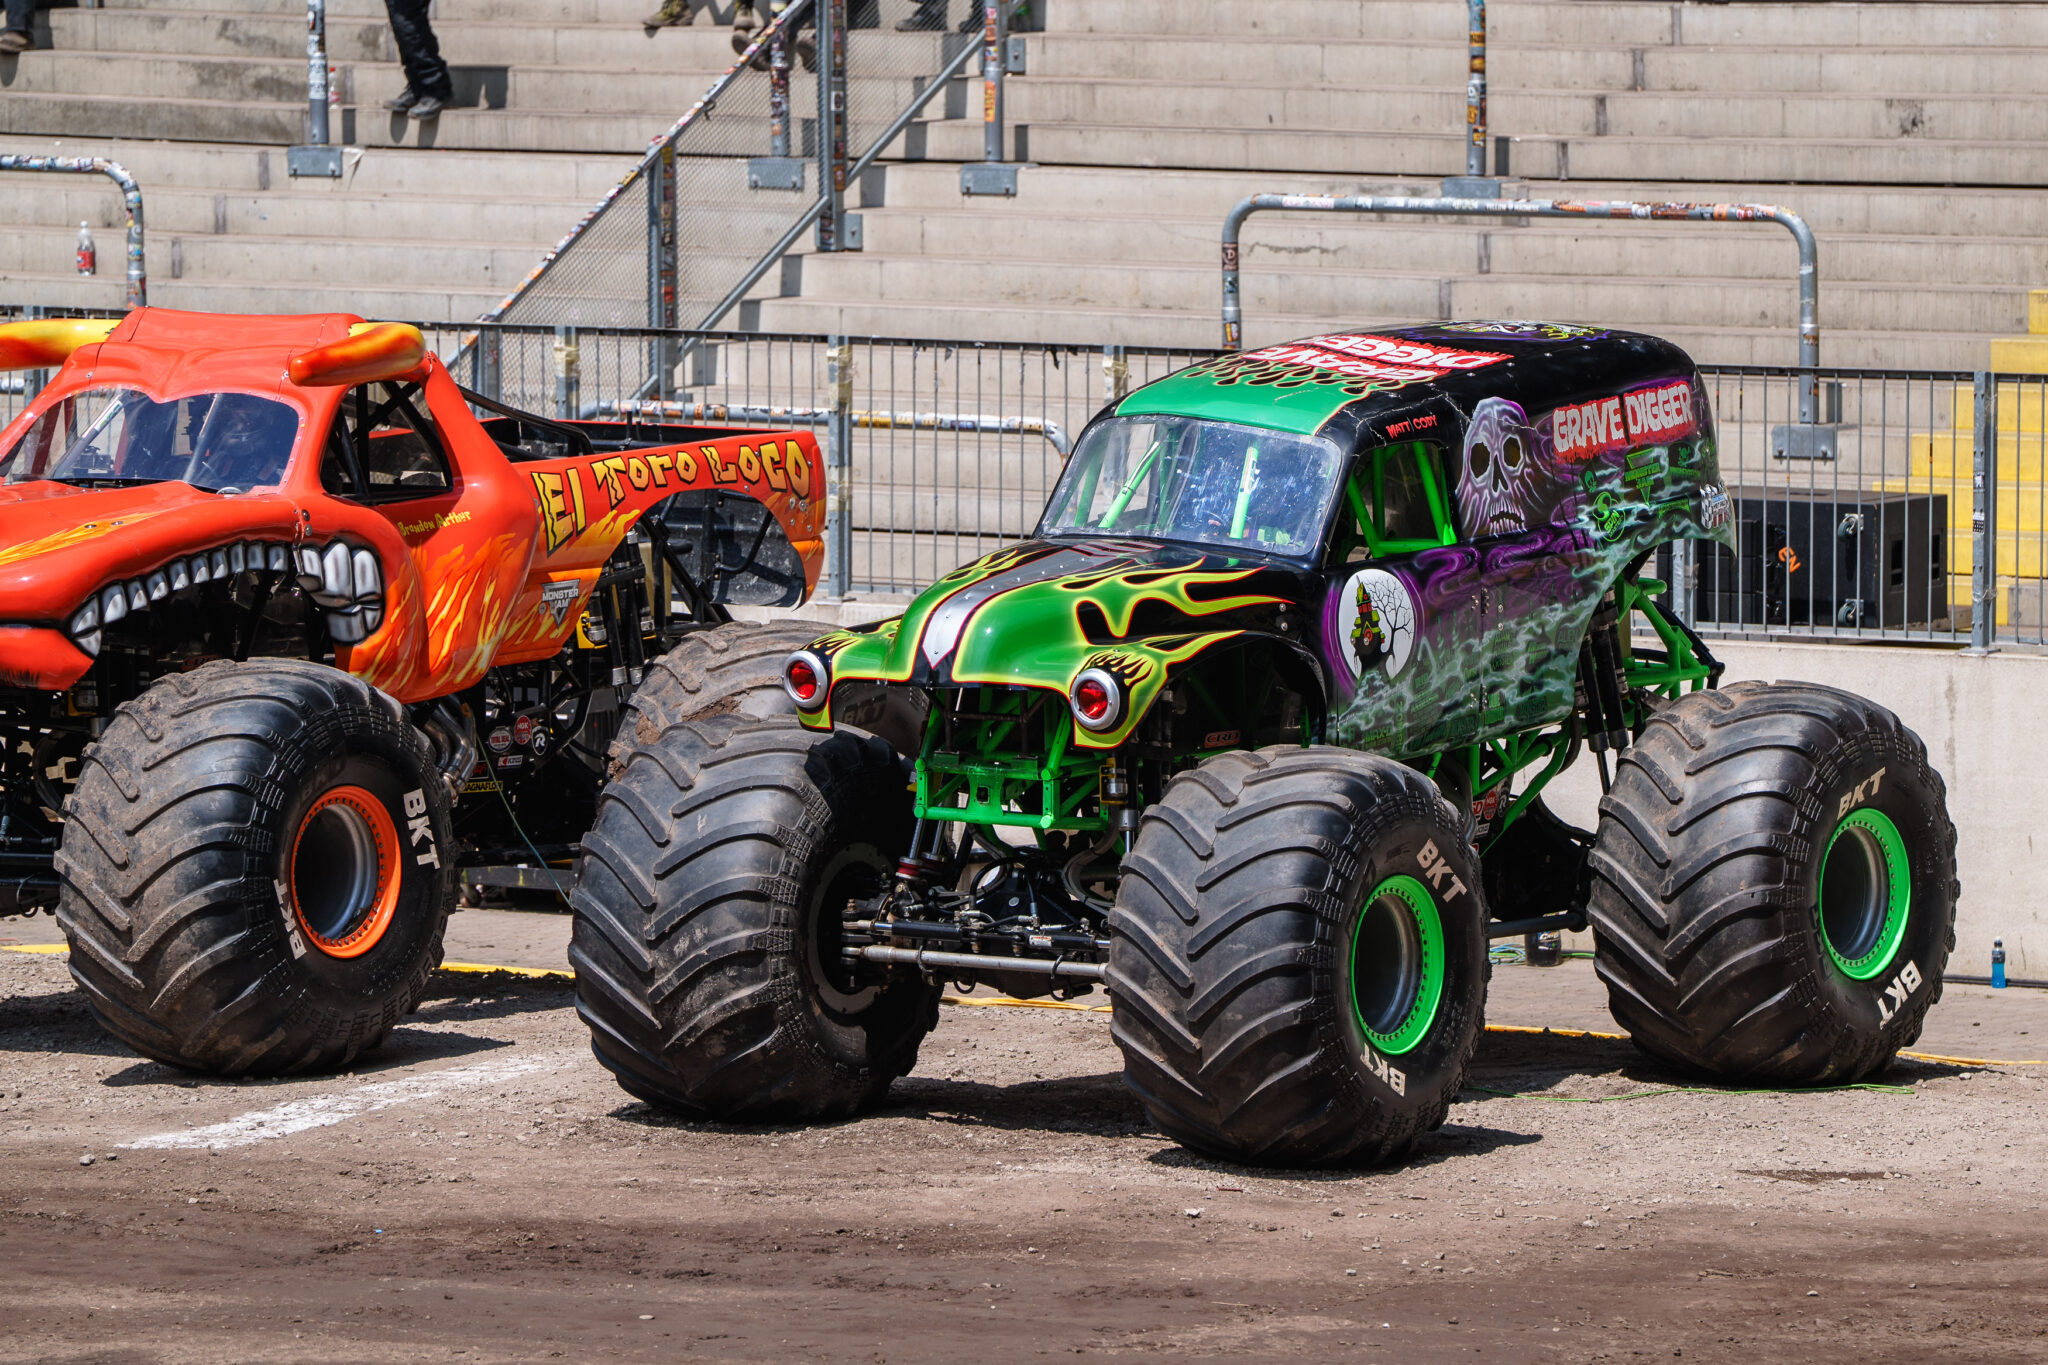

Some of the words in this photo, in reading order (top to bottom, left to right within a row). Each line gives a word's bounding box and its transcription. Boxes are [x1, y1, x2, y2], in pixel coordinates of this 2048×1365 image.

[1385, 421, 1411, 439] MATT
[1412, 414, 1437, 430] CODY
[1553, 397, 1625, 453] GRAVE
[1624, 384, 1693, 435] DIGGER
[397, 520, 435, 537] Brandon
[434, 510, 471, 529] Arthur
[542, 588, 579, 602] MONSTER
[1837, 766, 1886, 821] BKT
[403, 788, 441, 870] BKT
[1416, 837, 1468, 902] BKT
[273, 878, 307, 961] BKT
[1877, 959, 1923, 1031] BKT
[1360, 1042, 1407, 1097] BKT
